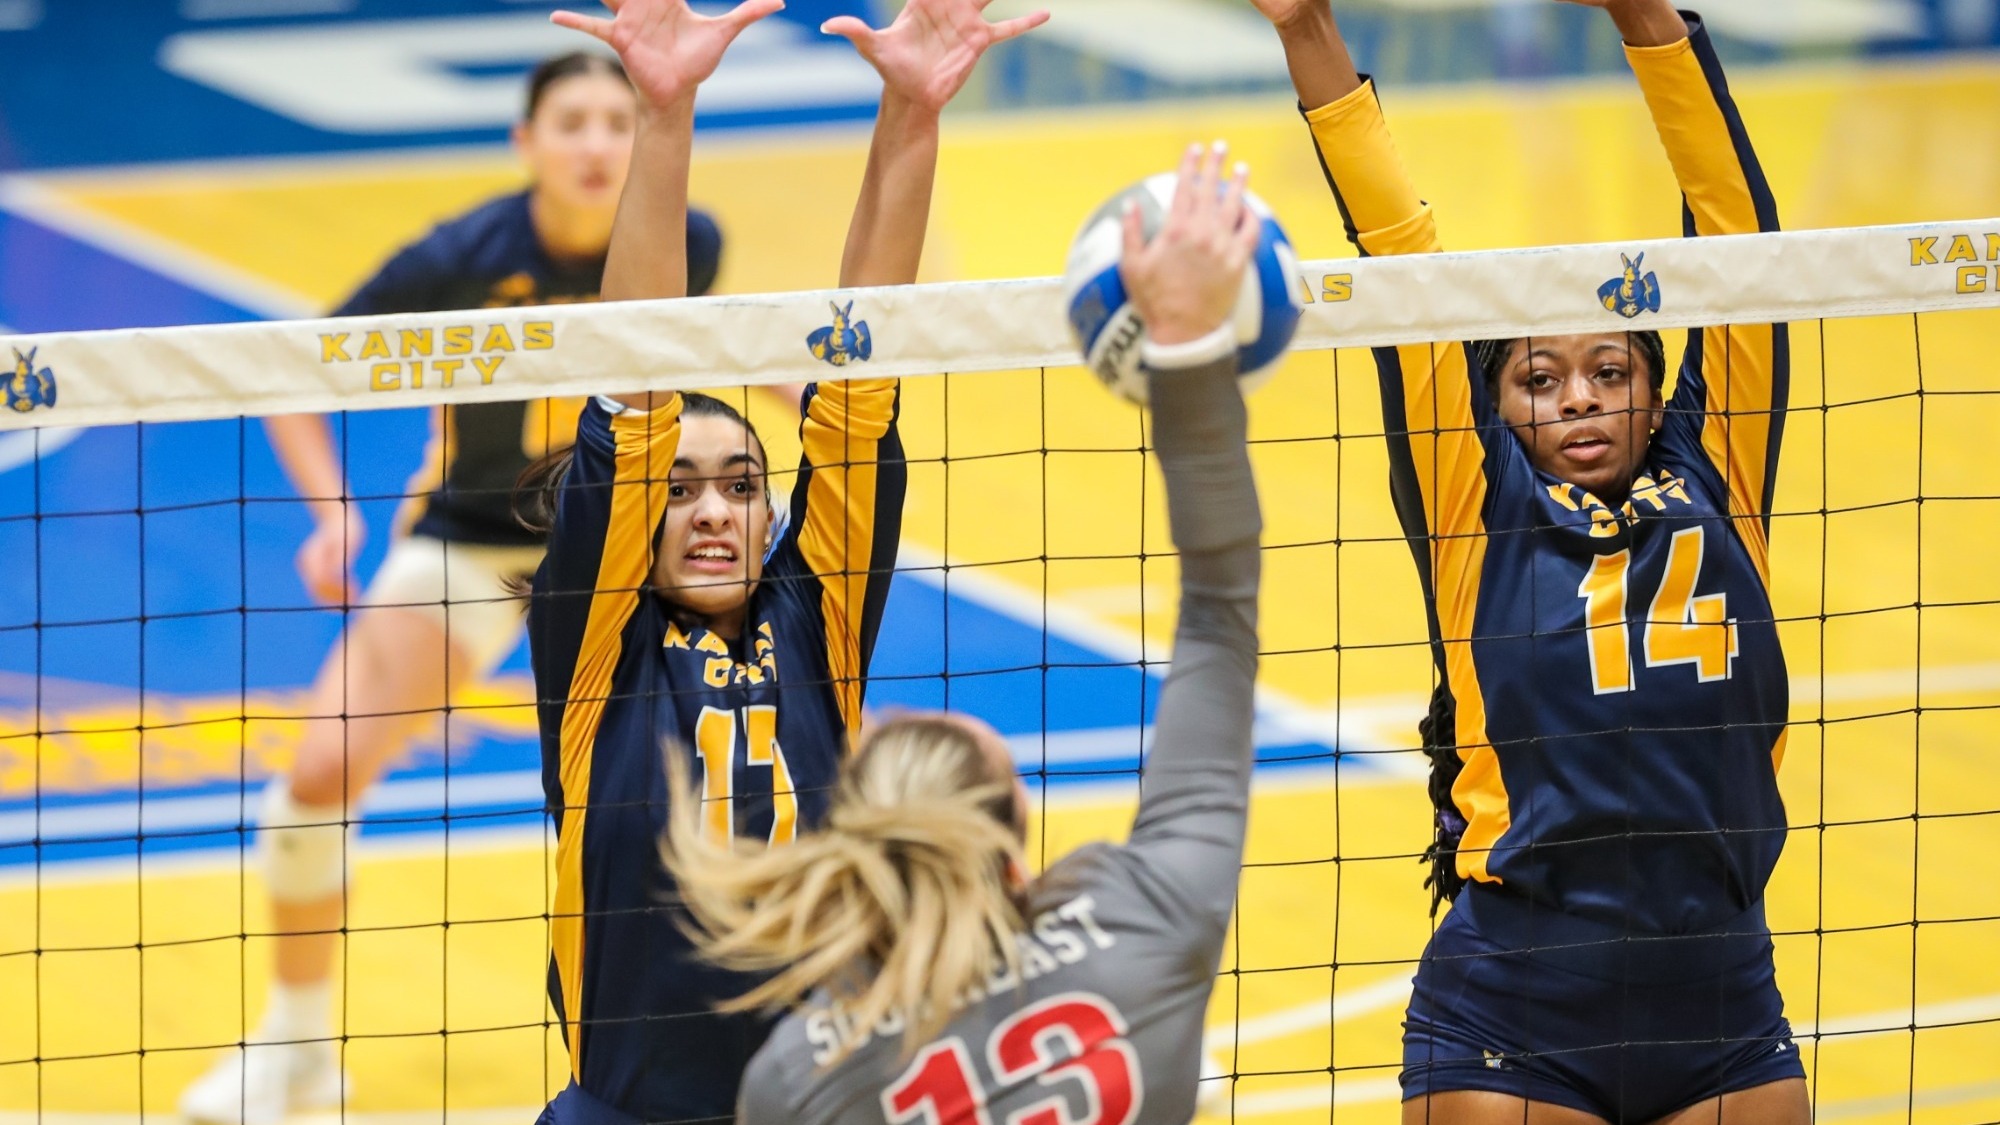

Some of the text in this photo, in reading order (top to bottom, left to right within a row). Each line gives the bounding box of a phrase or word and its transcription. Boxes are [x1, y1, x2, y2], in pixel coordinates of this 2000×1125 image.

[318, 320, 554, 363] KANSAS
[369, 356, 504, 391] CITY
[1577, 525, 1739, 695] 14
[695, 705, 798, 852] 17
[880, 991, 1144, 1125] 13
